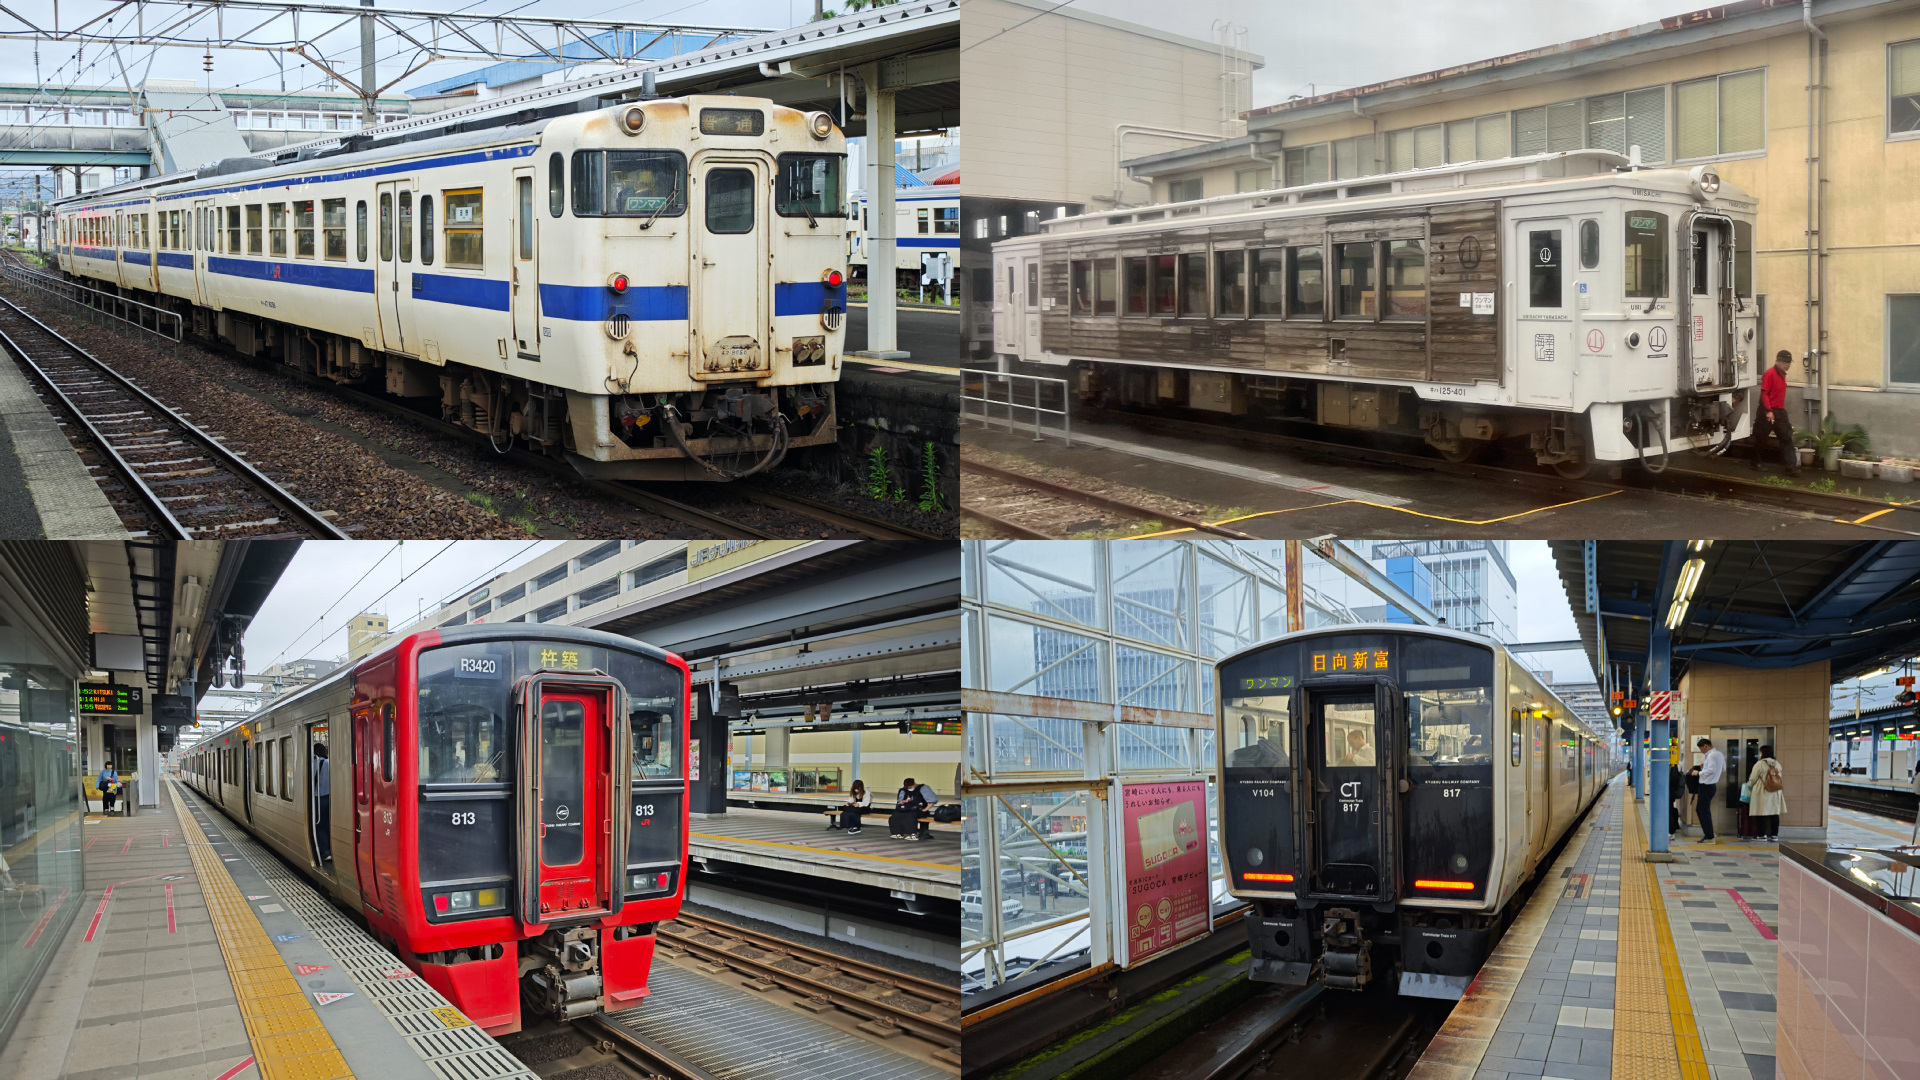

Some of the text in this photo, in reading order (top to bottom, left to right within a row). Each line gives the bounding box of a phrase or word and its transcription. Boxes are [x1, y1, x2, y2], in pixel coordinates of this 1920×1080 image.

[1632, 189, 1662, 197] UMISACHI
[629, 199, 665, 209] ワンマン
[1632, 218, 1656, 227] ワンマン
[541, 648, 579, 670] 杵築
[1313, 650, 1389, 671] 日向新富
[460, 658, 496, 673] R3420
[1246, 677, 1291, 690] ワンマン
[132, 690, 140, 700] 5
[1252, 789, 1275, 797] V104
[1340, 782, 1361, 798] CT
[1443, 788, 1461, 798] 817
[635, 804, 654, 816] 813
[1343, 803, 1360, 812] 817
[451, 812, 476, 825] 813
[640, 818, 651, 826] JR
